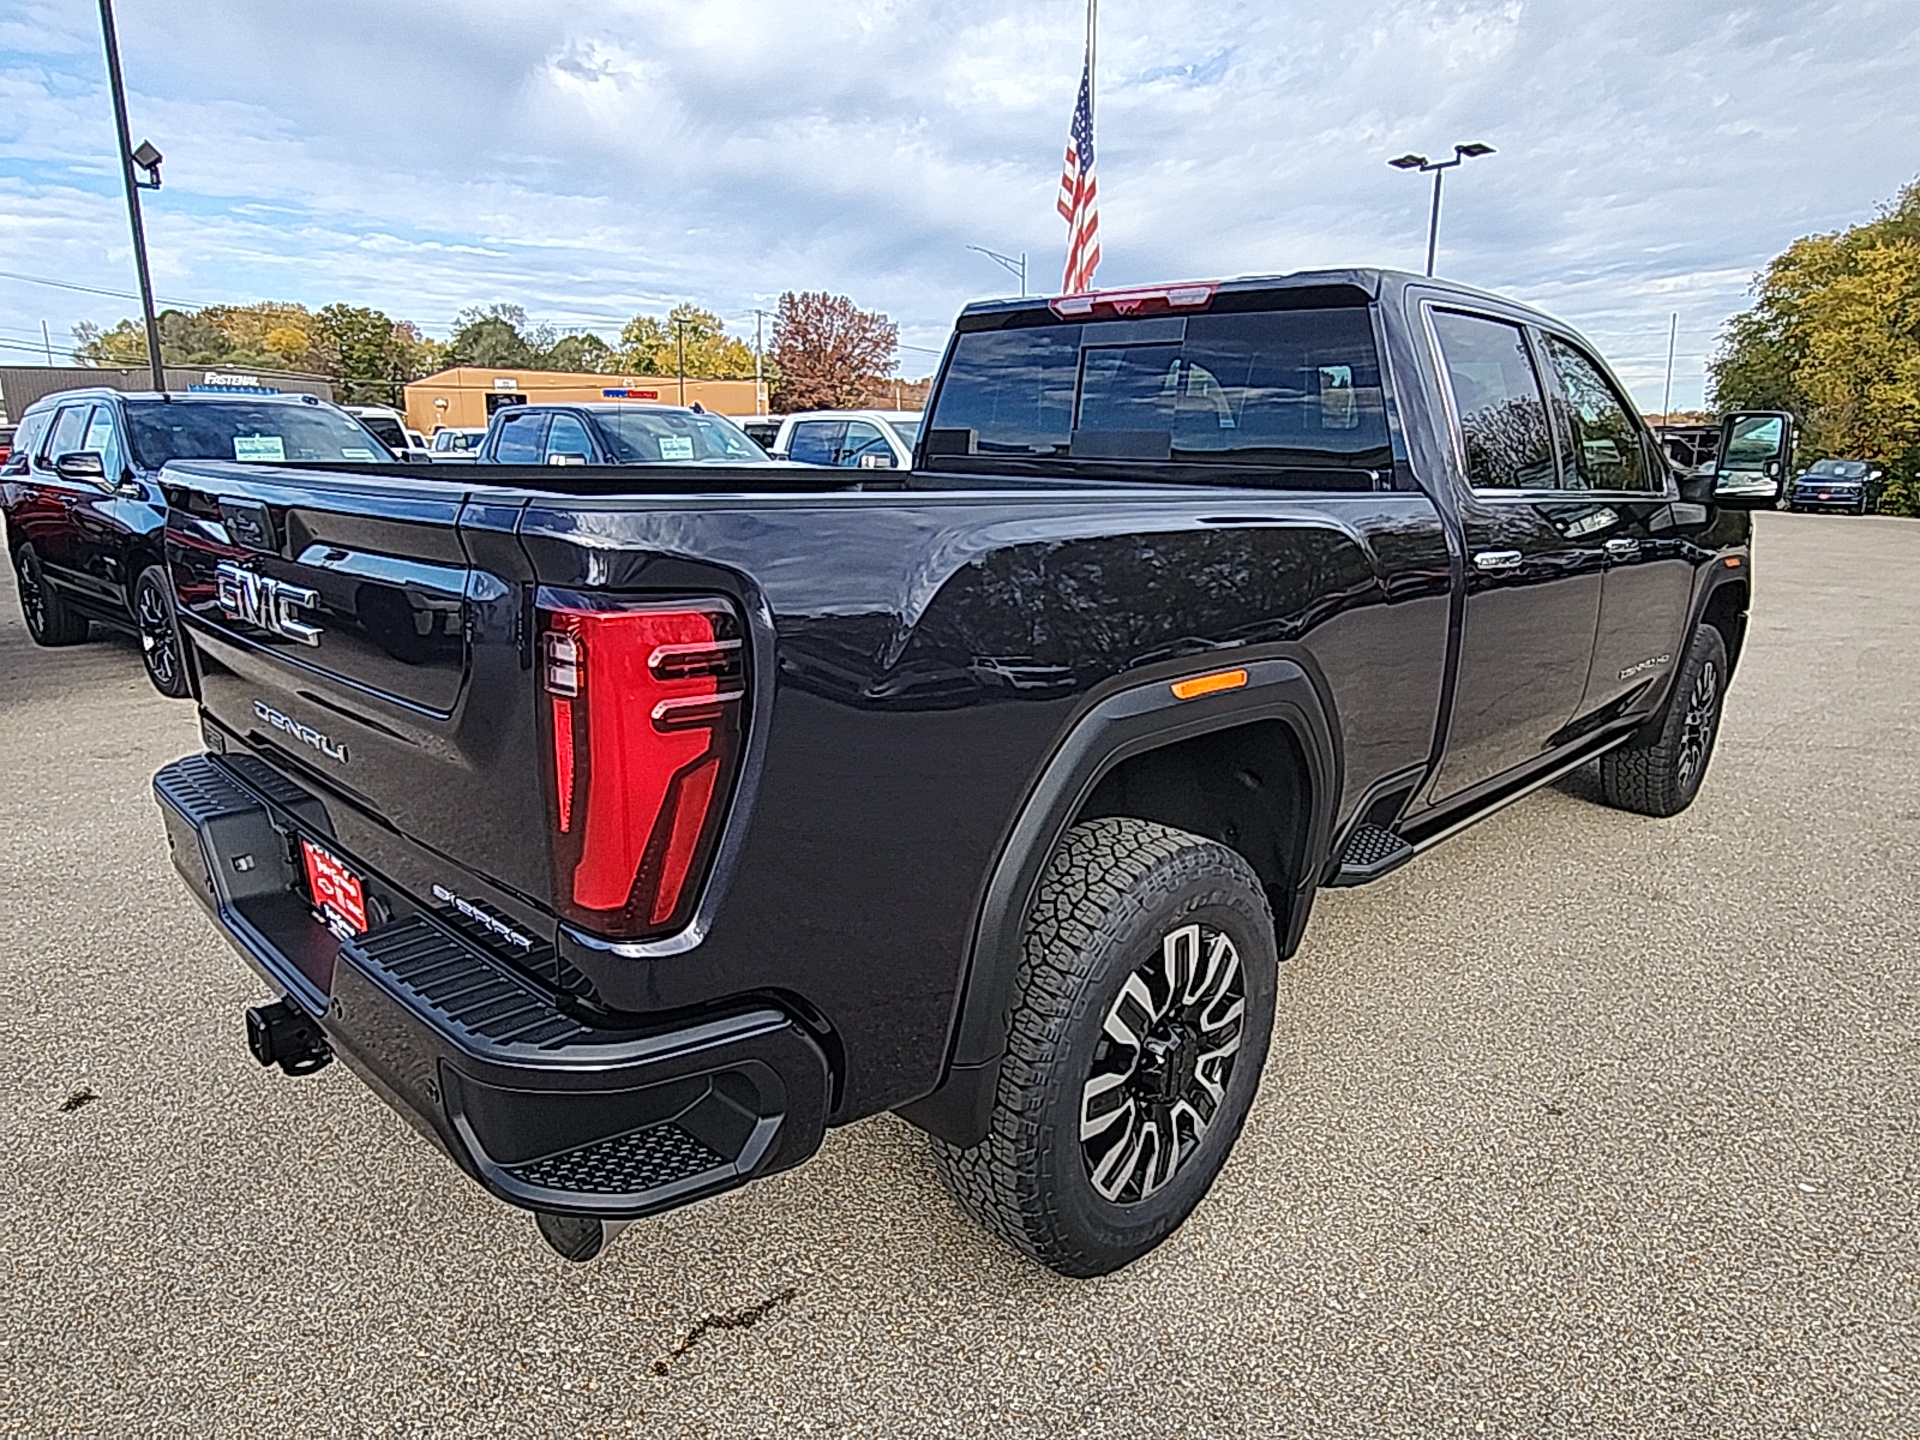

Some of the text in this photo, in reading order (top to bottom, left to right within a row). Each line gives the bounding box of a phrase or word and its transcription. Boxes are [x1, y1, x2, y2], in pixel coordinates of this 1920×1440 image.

[204, 371, 260, 387] FASTENAL
[215, 563, 324, 648] GMC
[252, 698, 350, 765] DENALI
[432, 882, 534, 953] SIERRA
